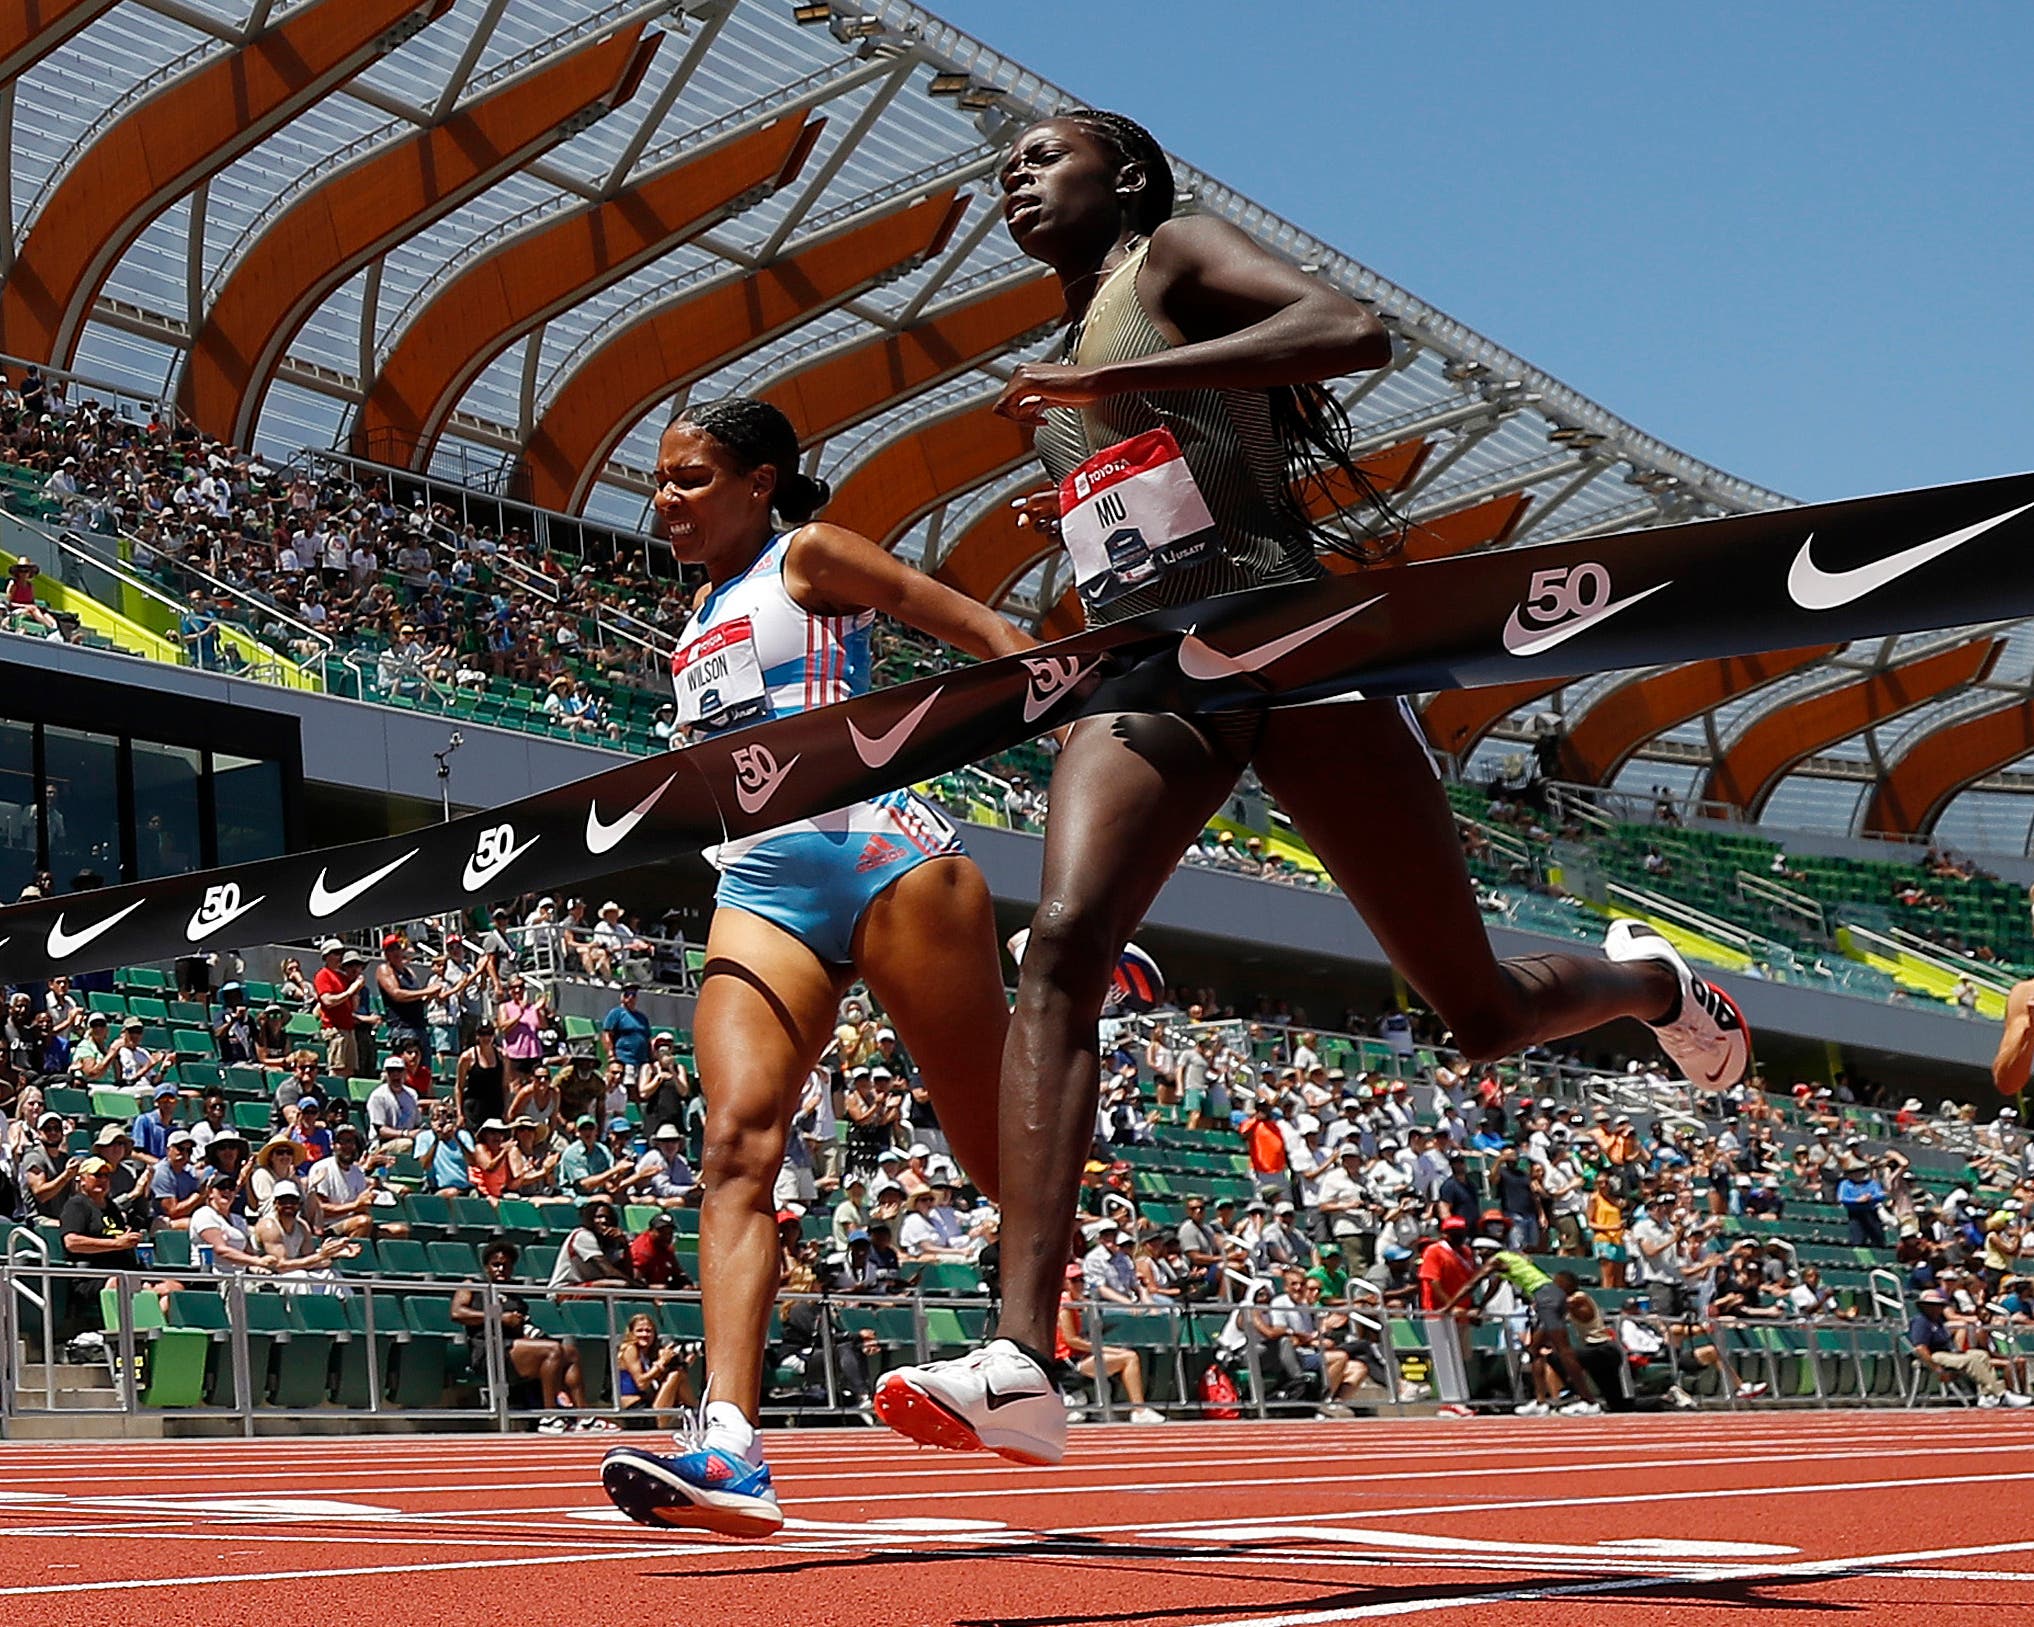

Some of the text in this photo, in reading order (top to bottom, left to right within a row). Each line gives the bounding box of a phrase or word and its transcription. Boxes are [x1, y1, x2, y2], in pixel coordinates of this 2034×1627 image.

[1089, 458, 1130, 484] TOYOTA
[1094, 491, 1126, 529] MU
[1526, 561, 1612, 622] 50
[687, 653, 729, 692] WILSON
[731, 743, 779, 789] 50
[475, 823, 515, 868] 50
[855, 847, 908, 873] adidas
[201, 882, 241, 921] 50
